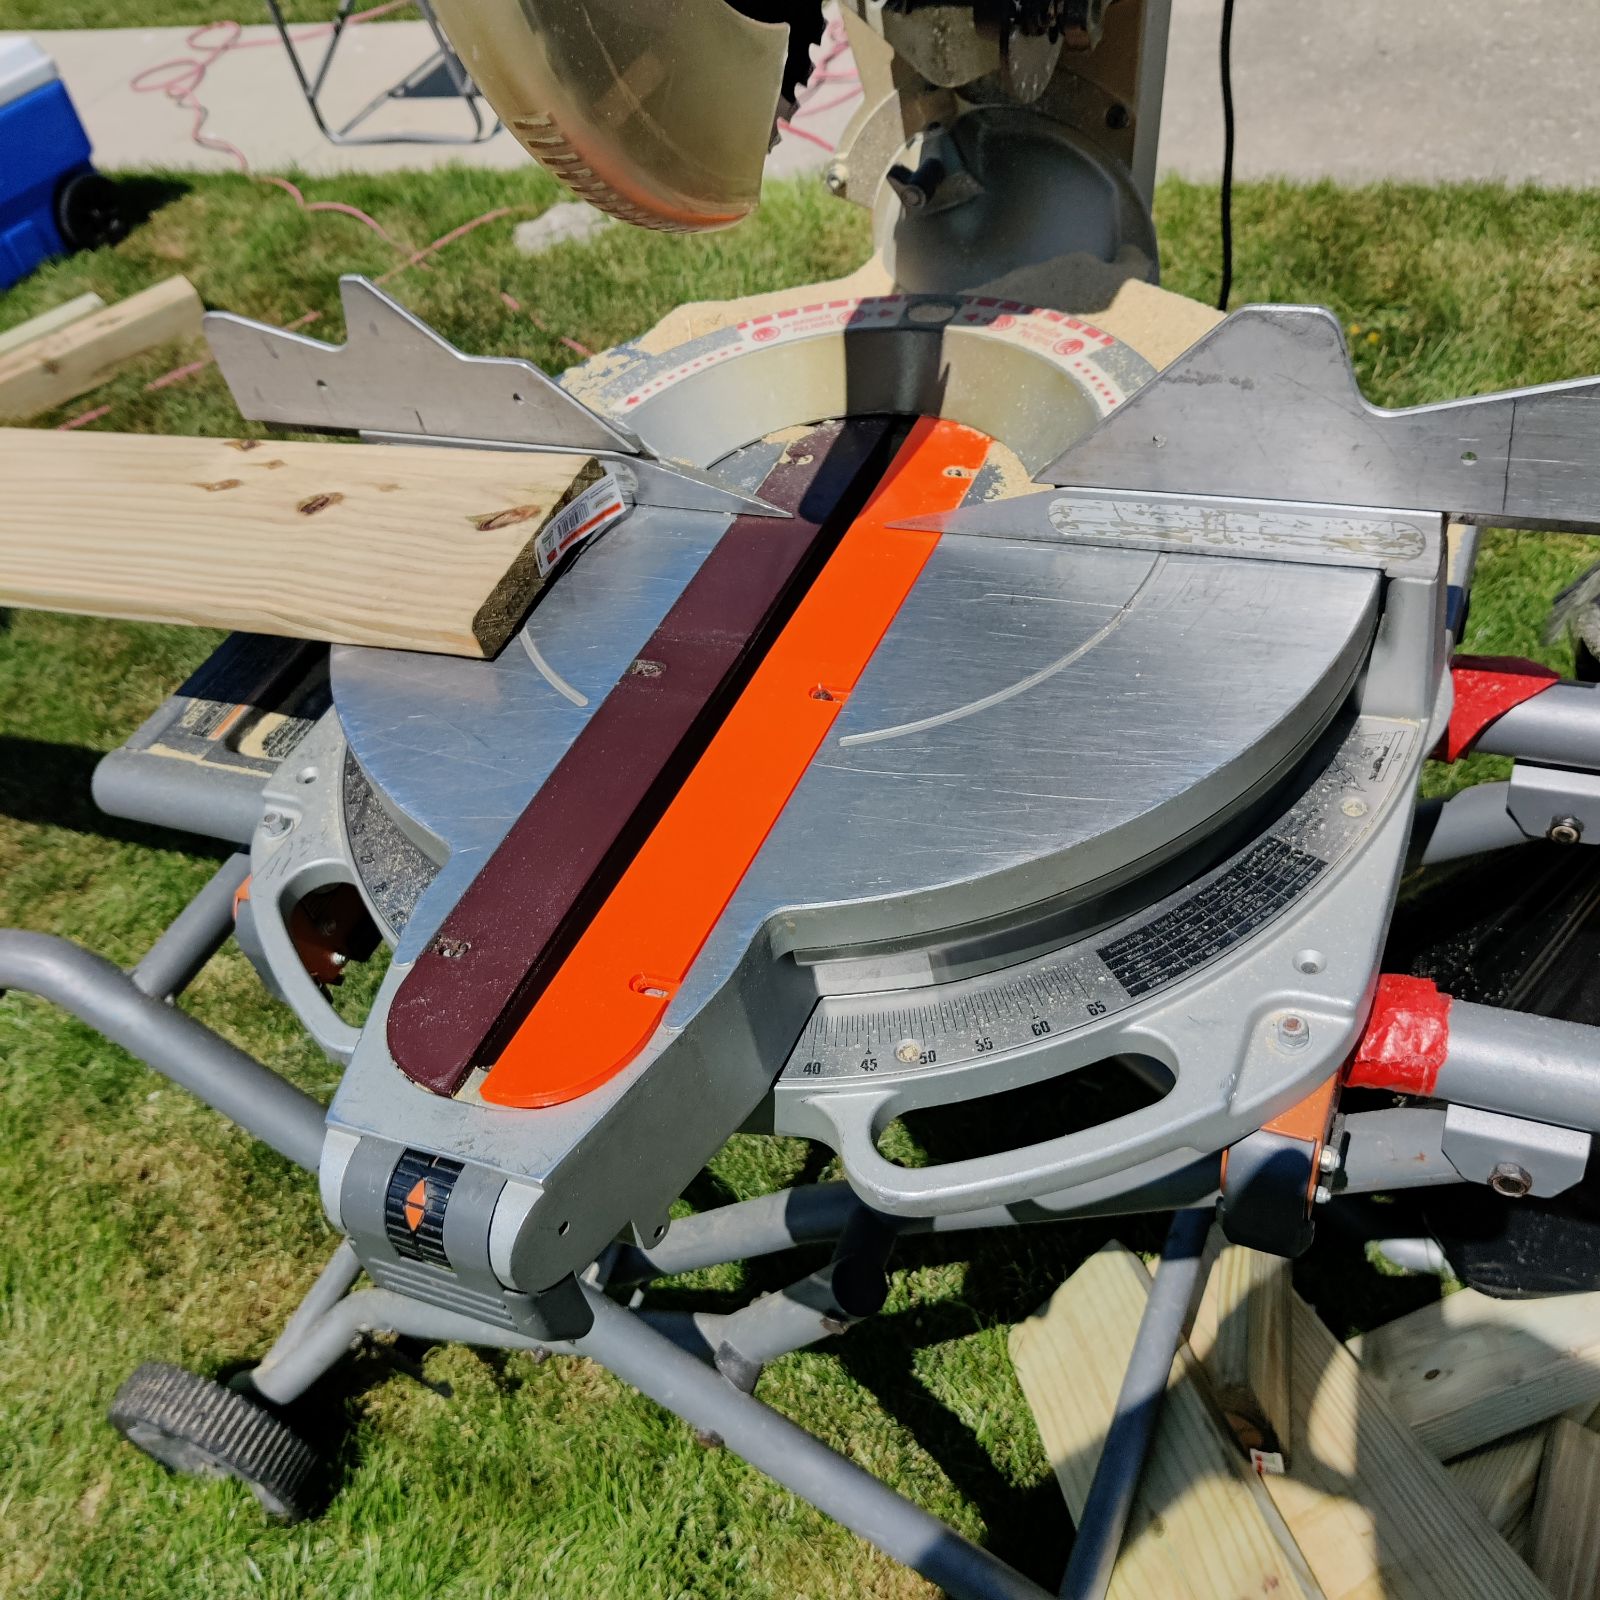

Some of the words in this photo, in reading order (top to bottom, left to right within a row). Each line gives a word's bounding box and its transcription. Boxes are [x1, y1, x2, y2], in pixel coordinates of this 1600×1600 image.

[803, 1061, 821, 1075] 40
[859, 1058, 878, 1072] 45
[919, 1050, 936, 1065] 50
[974, 1037, 993, 1052] 55
[1030, 1020, 1051, 1036] 60
[1086, 1001, 1107, 1016] 65
